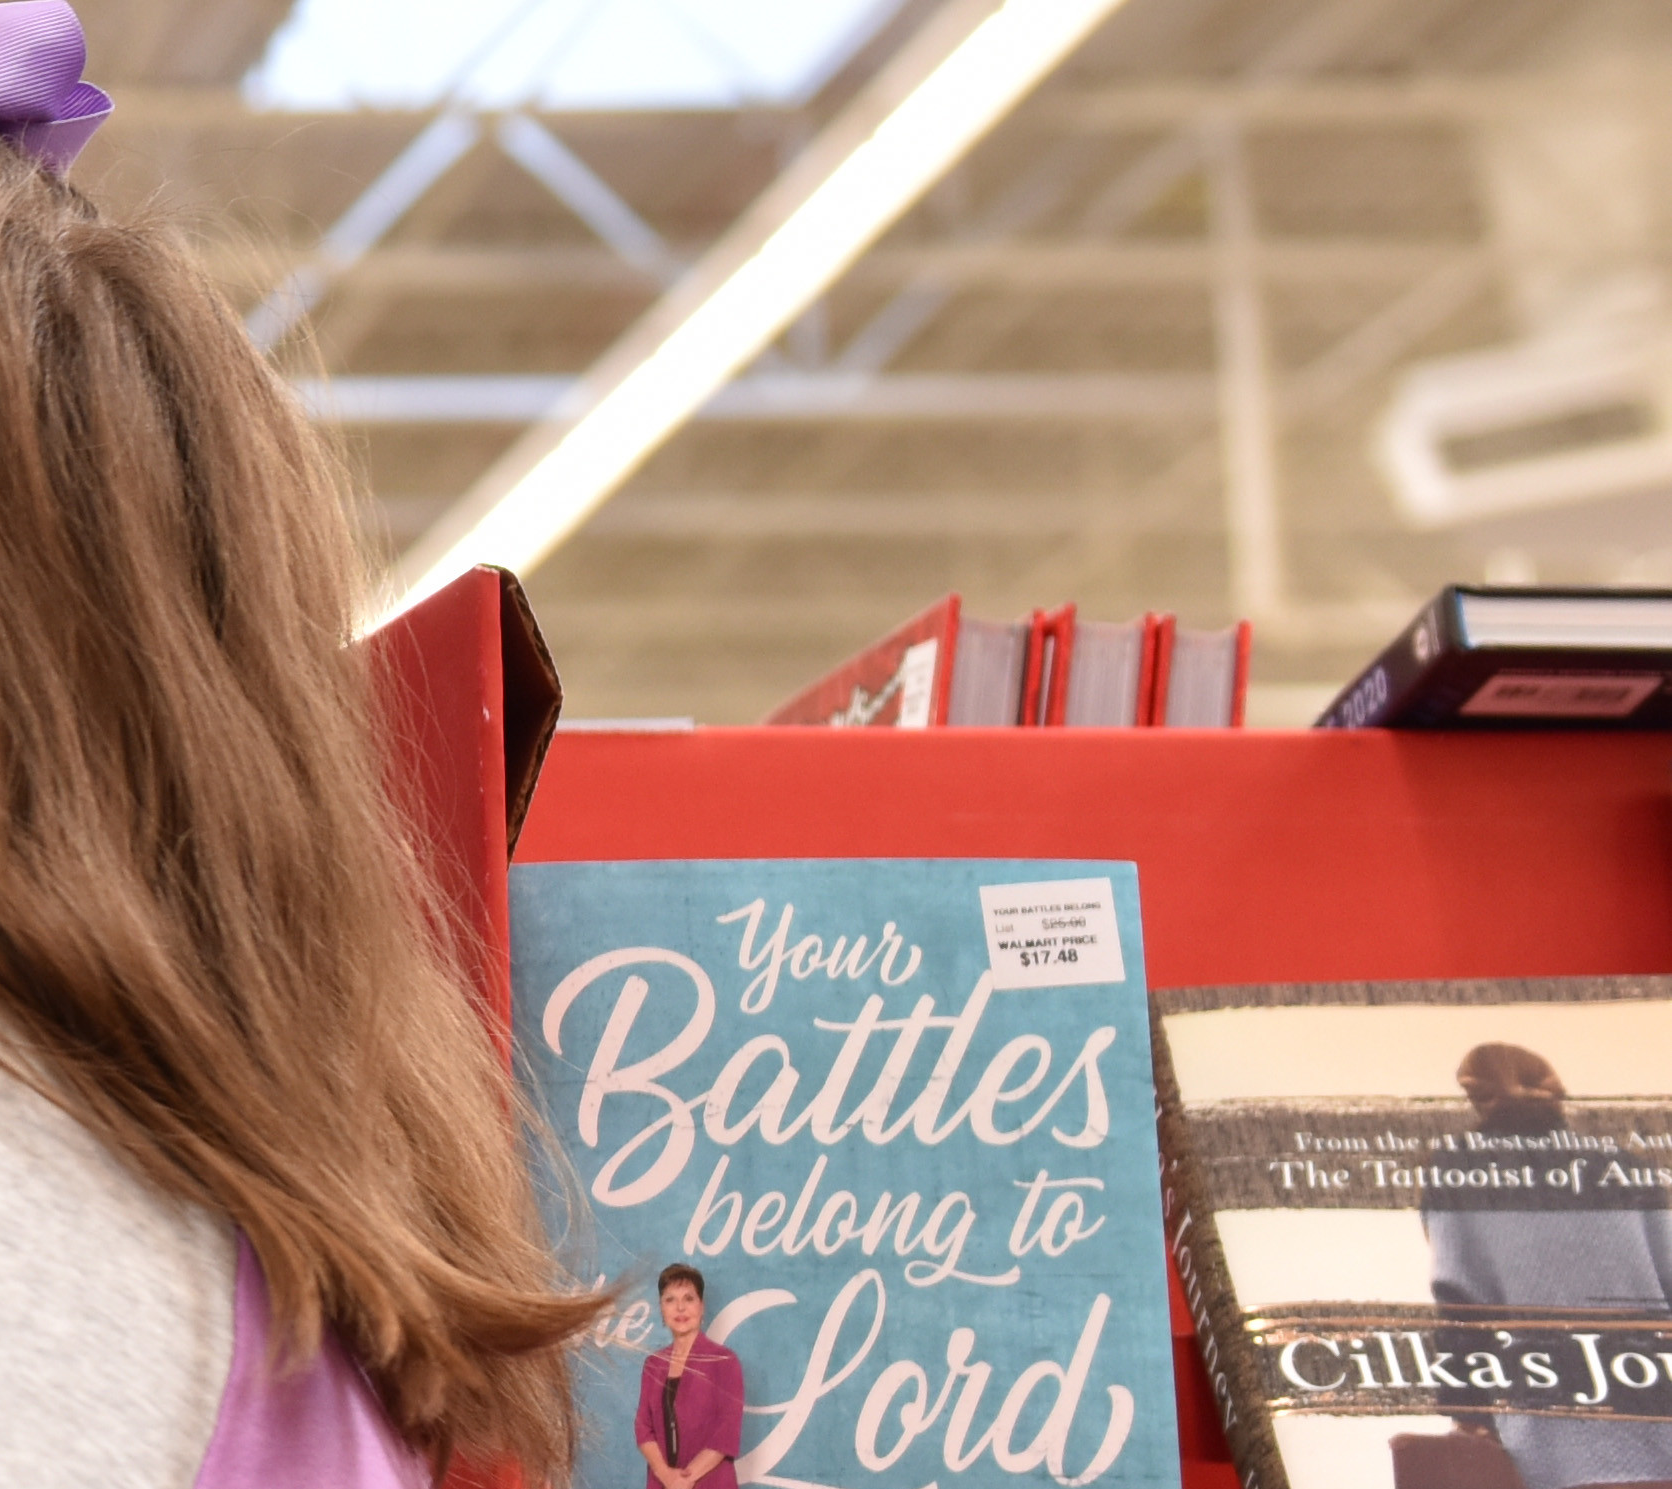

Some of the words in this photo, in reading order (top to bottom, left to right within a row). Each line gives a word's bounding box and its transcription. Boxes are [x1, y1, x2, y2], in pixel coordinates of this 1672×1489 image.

[1021, 903, 1062, 914] BATTLES
[717, 897, 922, 1014] Your
[998, 937, 1059, 950] WALMART
[1062, 934, 1098, 945] PRICE
[1019, 948, 1079, 968] $17.48
[542, 946, 1117, 1207] Battles
[1294, 1131, 1370, 1152] From
[1376, 1130, 1420, 1152] the
[1463, 1130, 1619, 1153] Bestselling
[1268, 1158, 1351, 1189] The
[1361, 1159, 1535, 1189] Tattooist
[1545, 1158, 1588, 1196] of
[683, 1153, 1021, 1288] belong
[1008, 1168, 1106, 1258] to
[1279, 1330, 1560, 1392] Cilka's
[1570, 1332, 1672, 1405] Jo
